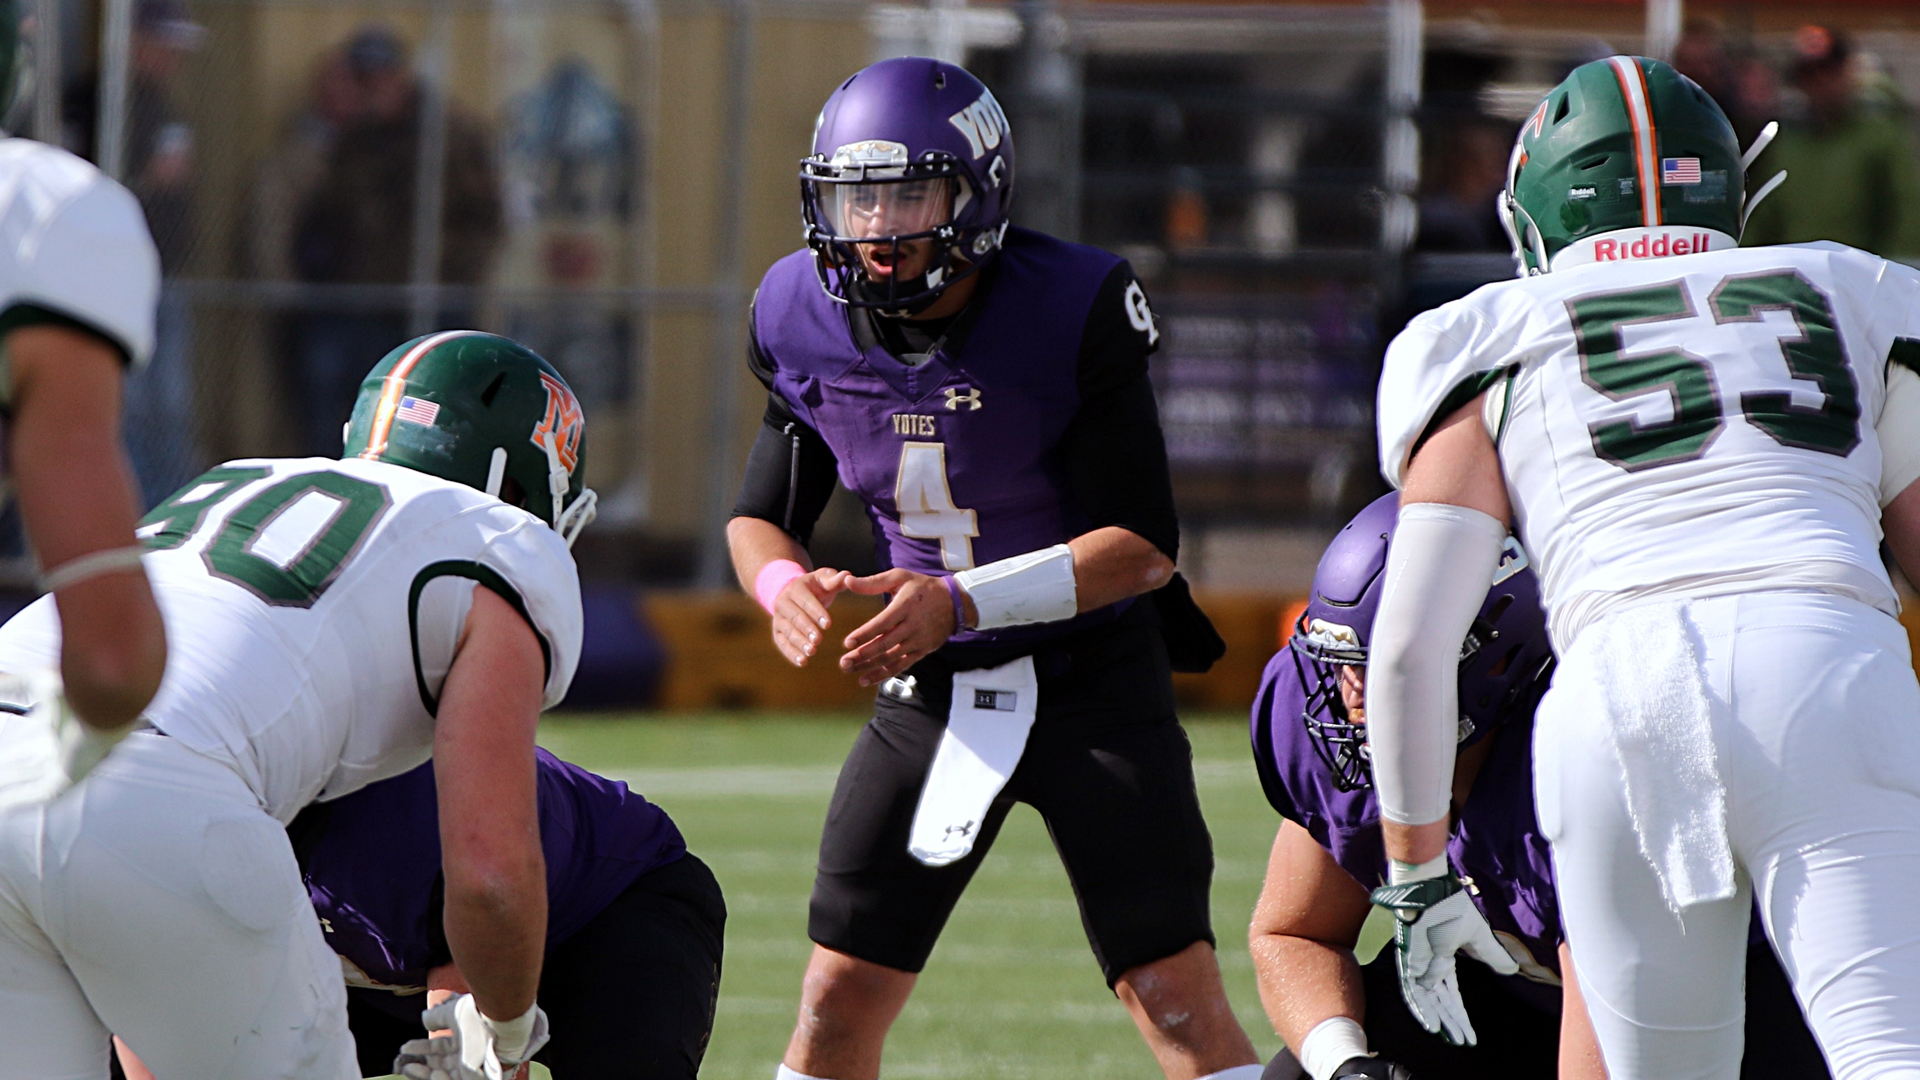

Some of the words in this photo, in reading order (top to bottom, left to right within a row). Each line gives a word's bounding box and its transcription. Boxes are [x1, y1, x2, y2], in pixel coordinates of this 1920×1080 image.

[1594, 233, 1710, 262] Riddell
[1564, 266, 1863, 473] 53
[892, 414, 936, 436] YOTES
[895, 441, 981, 571] 4
